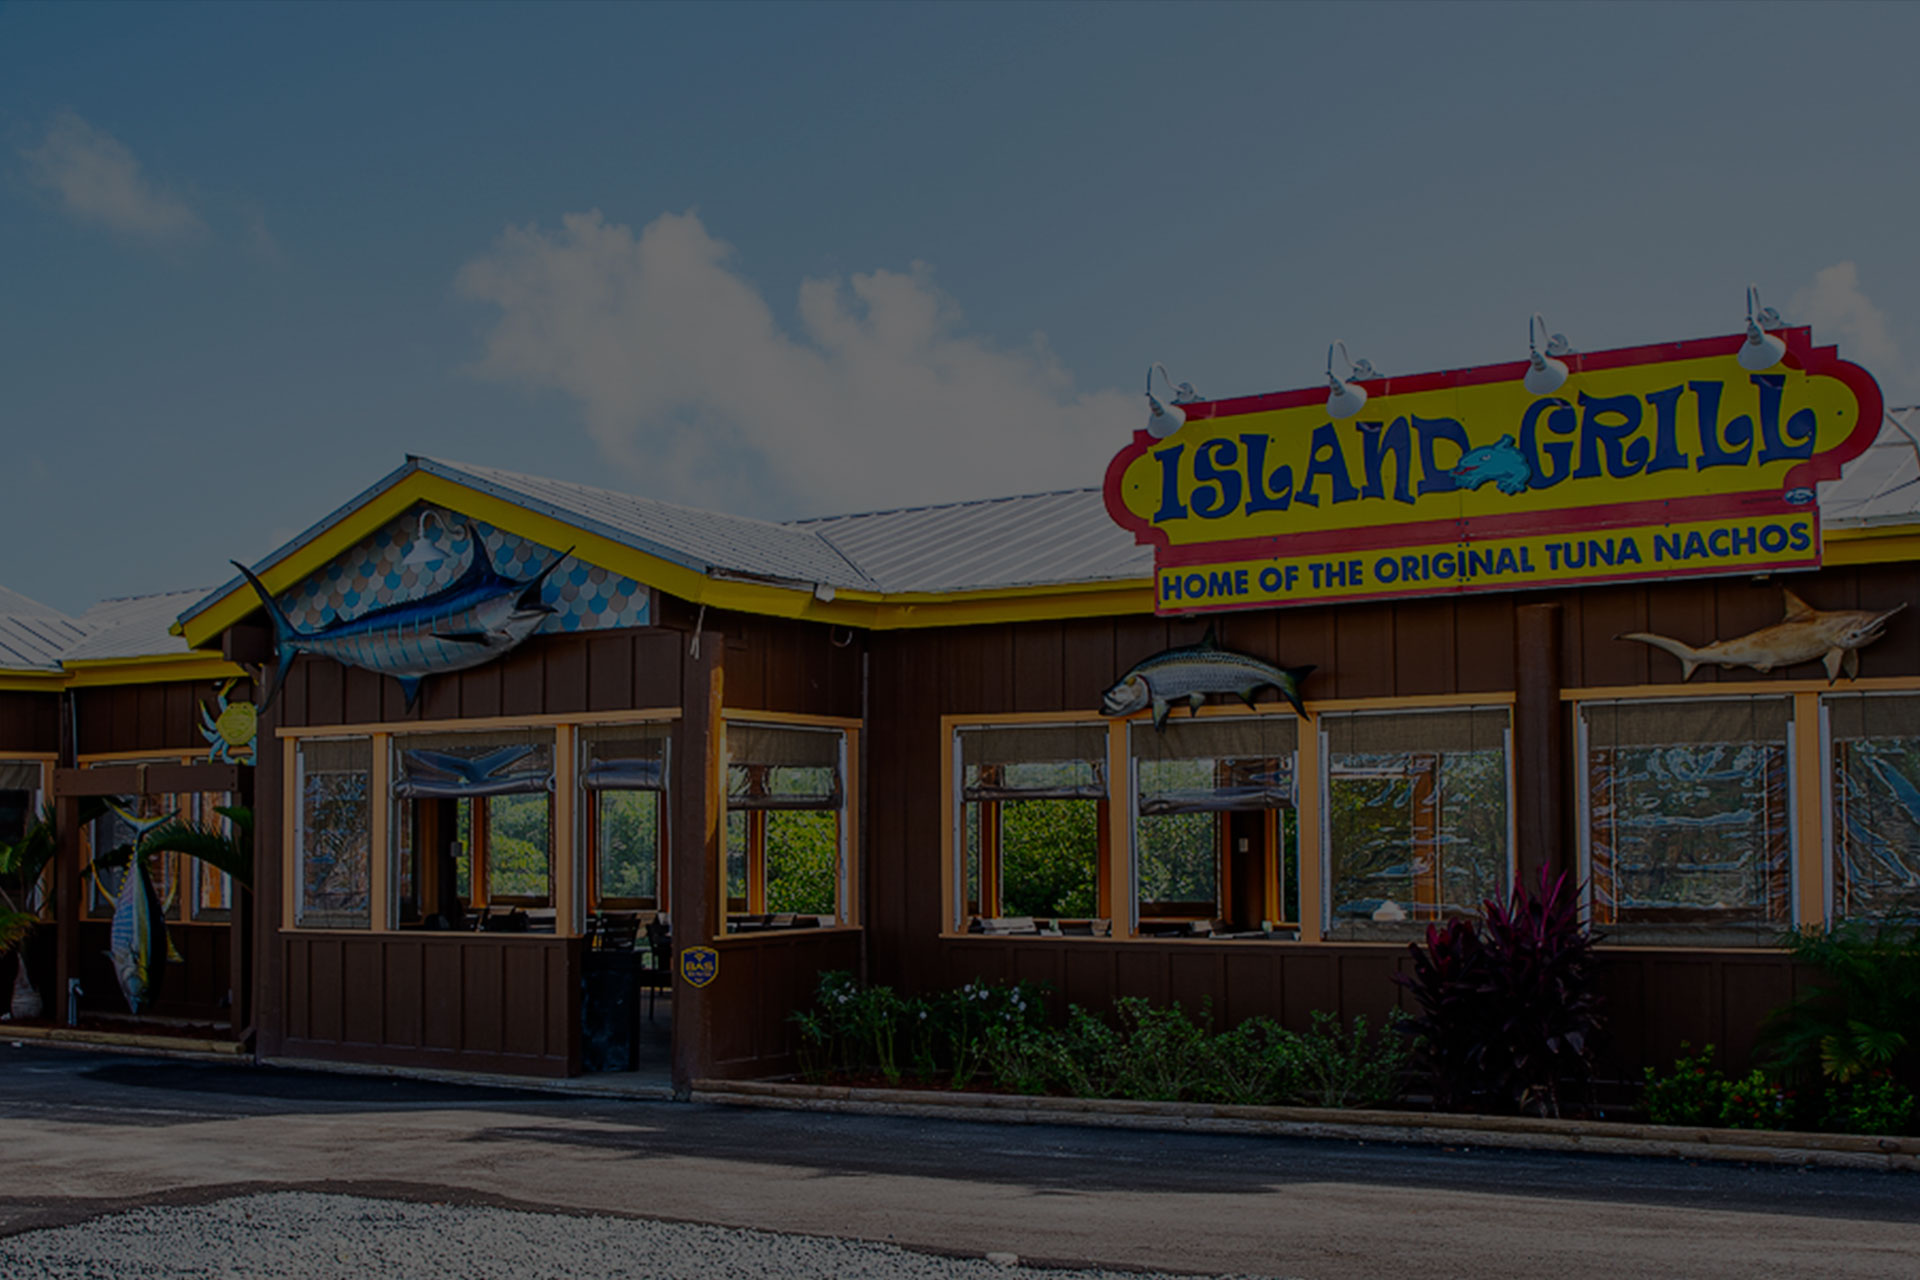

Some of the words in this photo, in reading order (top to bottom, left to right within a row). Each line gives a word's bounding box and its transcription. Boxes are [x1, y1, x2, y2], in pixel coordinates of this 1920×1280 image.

[1154, 415, 1470, 523] ISLAND
[1521, 374, 1817, 489] GRILL
[1162, 570, 1250, 601] HOME
[1258, 566, 1300, 593] OF
[1309, 560, 1363, 589] THE
[1373, 545, 1536, 584] ORIGINAL
[1545, 536, 1642, 571] TUNA
[1653, 522, 1811, 562] NACHOS
